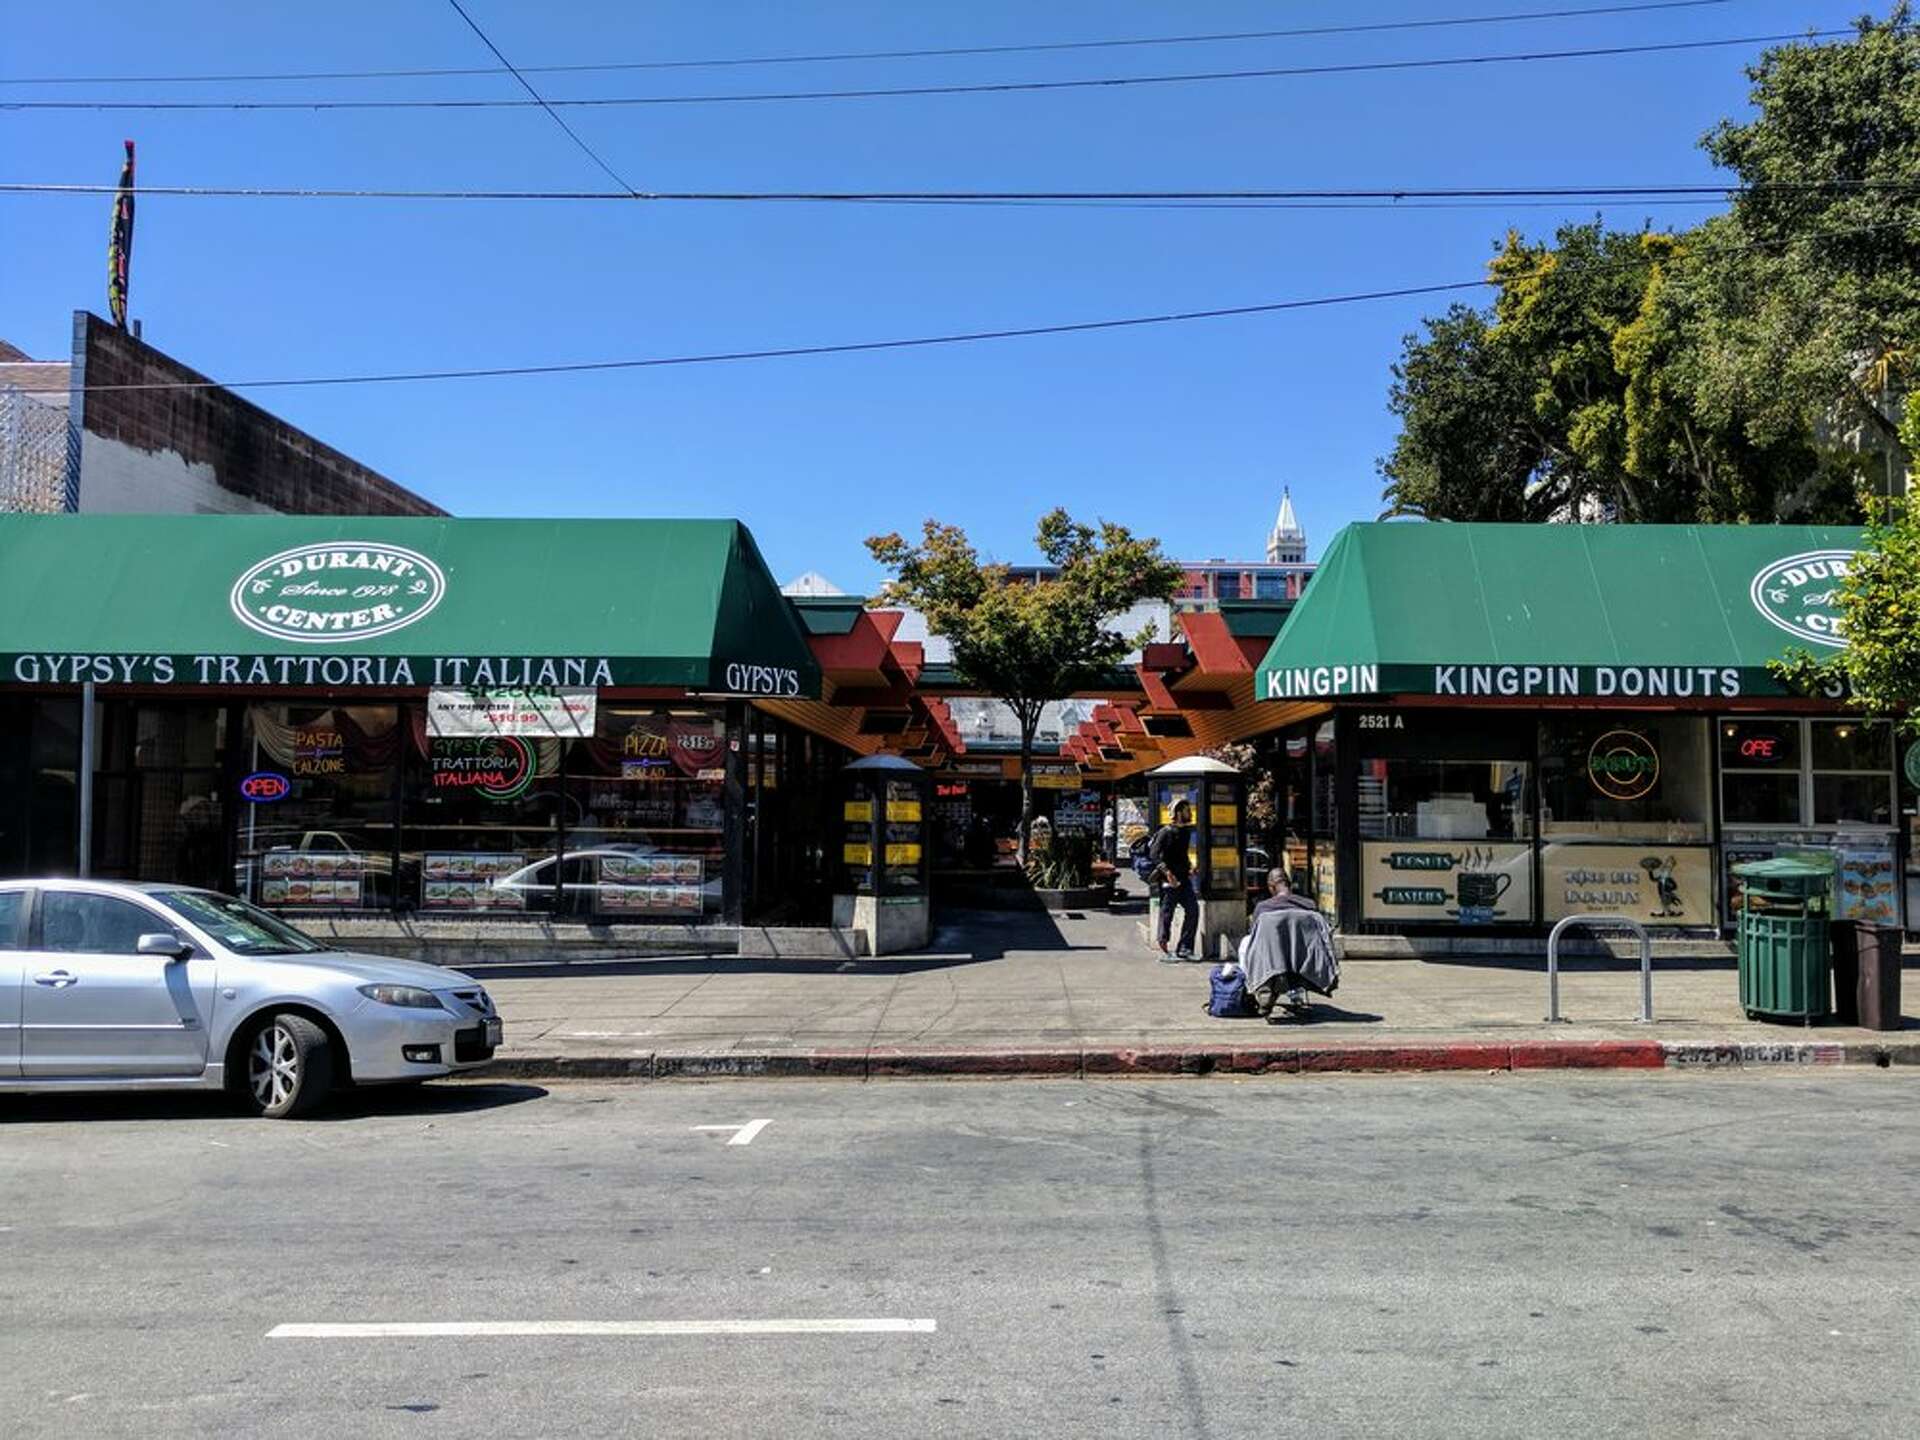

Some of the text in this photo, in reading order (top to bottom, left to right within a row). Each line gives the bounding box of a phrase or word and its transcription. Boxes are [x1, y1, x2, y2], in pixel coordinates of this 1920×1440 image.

[280, 552, 414, 578] DURANT
[1786, 559, 1858, 587] DUR
[279, 580, 348, 597] Since
[266, 603, 396, 630] CENTER
[14, 655, 615, 686] GYPSY'S TRATTORIA ITALIANA
[726, 663, 799, 695] GYPSY'S
[1267, 664, 1378, 697] KINGPIN
[1434, 666, 1740, 697] KINGPIN DONUTS
[1359, 715, 1404, 729] 2521 A
[296, 732, 345, 748] PASTA
[624, 734, 669, 756] PIZZA
[292, 758, 346, 775] CALZONE
[432, 757, 519, 770] TRATTORIA
[246, 778, 286, 796] OPEN
[434, 772, 506, 787] ITALIANA
[1396, 856, 1452, 867] DONUTS
[1388, 891, 1443, 903] PASTRIES
